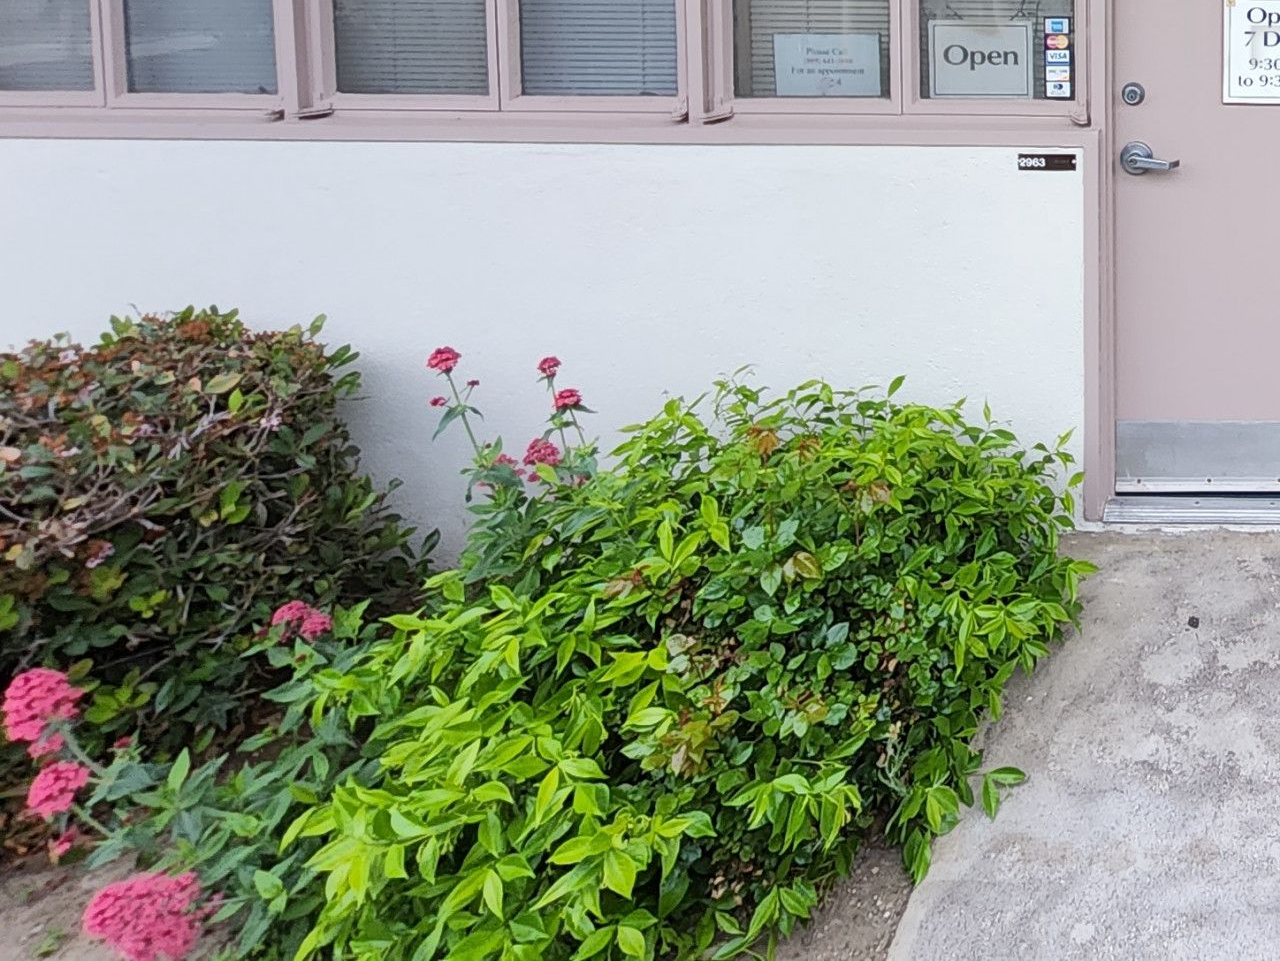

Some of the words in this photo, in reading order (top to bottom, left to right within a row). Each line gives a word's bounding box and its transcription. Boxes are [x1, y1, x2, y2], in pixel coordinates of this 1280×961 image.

[1243, 30, 1257, 47] 7
[943, 44, 1020, 71] Open
[1048, 52, 1068, 60] VISA
[1238, 75, 1254, 87] to
[1020, 157, 1046, 168] 2963
